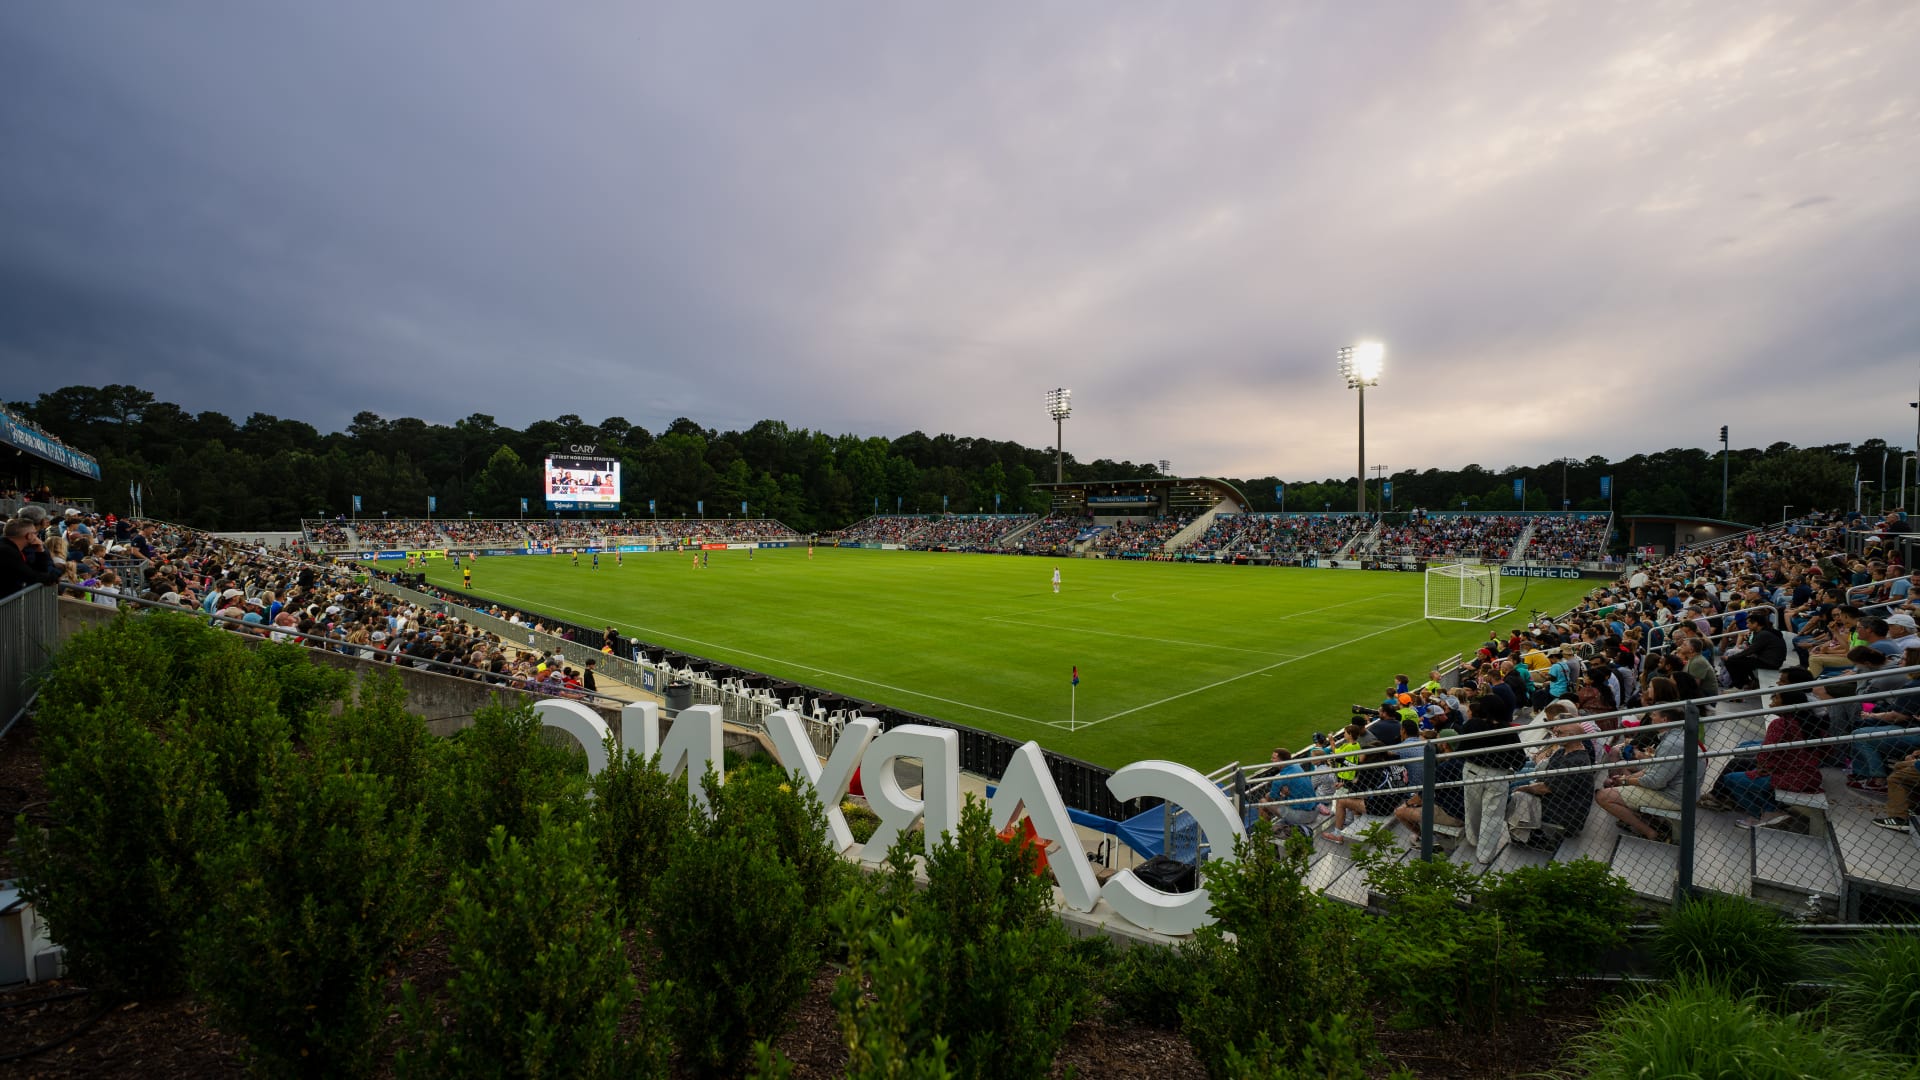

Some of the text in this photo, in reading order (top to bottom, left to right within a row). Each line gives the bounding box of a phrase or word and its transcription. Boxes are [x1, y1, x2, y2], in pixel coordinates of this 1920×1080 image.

[570, 444, 596, 453] CARY
[1509, 566, 1580, 579] athletic lab
[643, 672, 655, 687] 310
